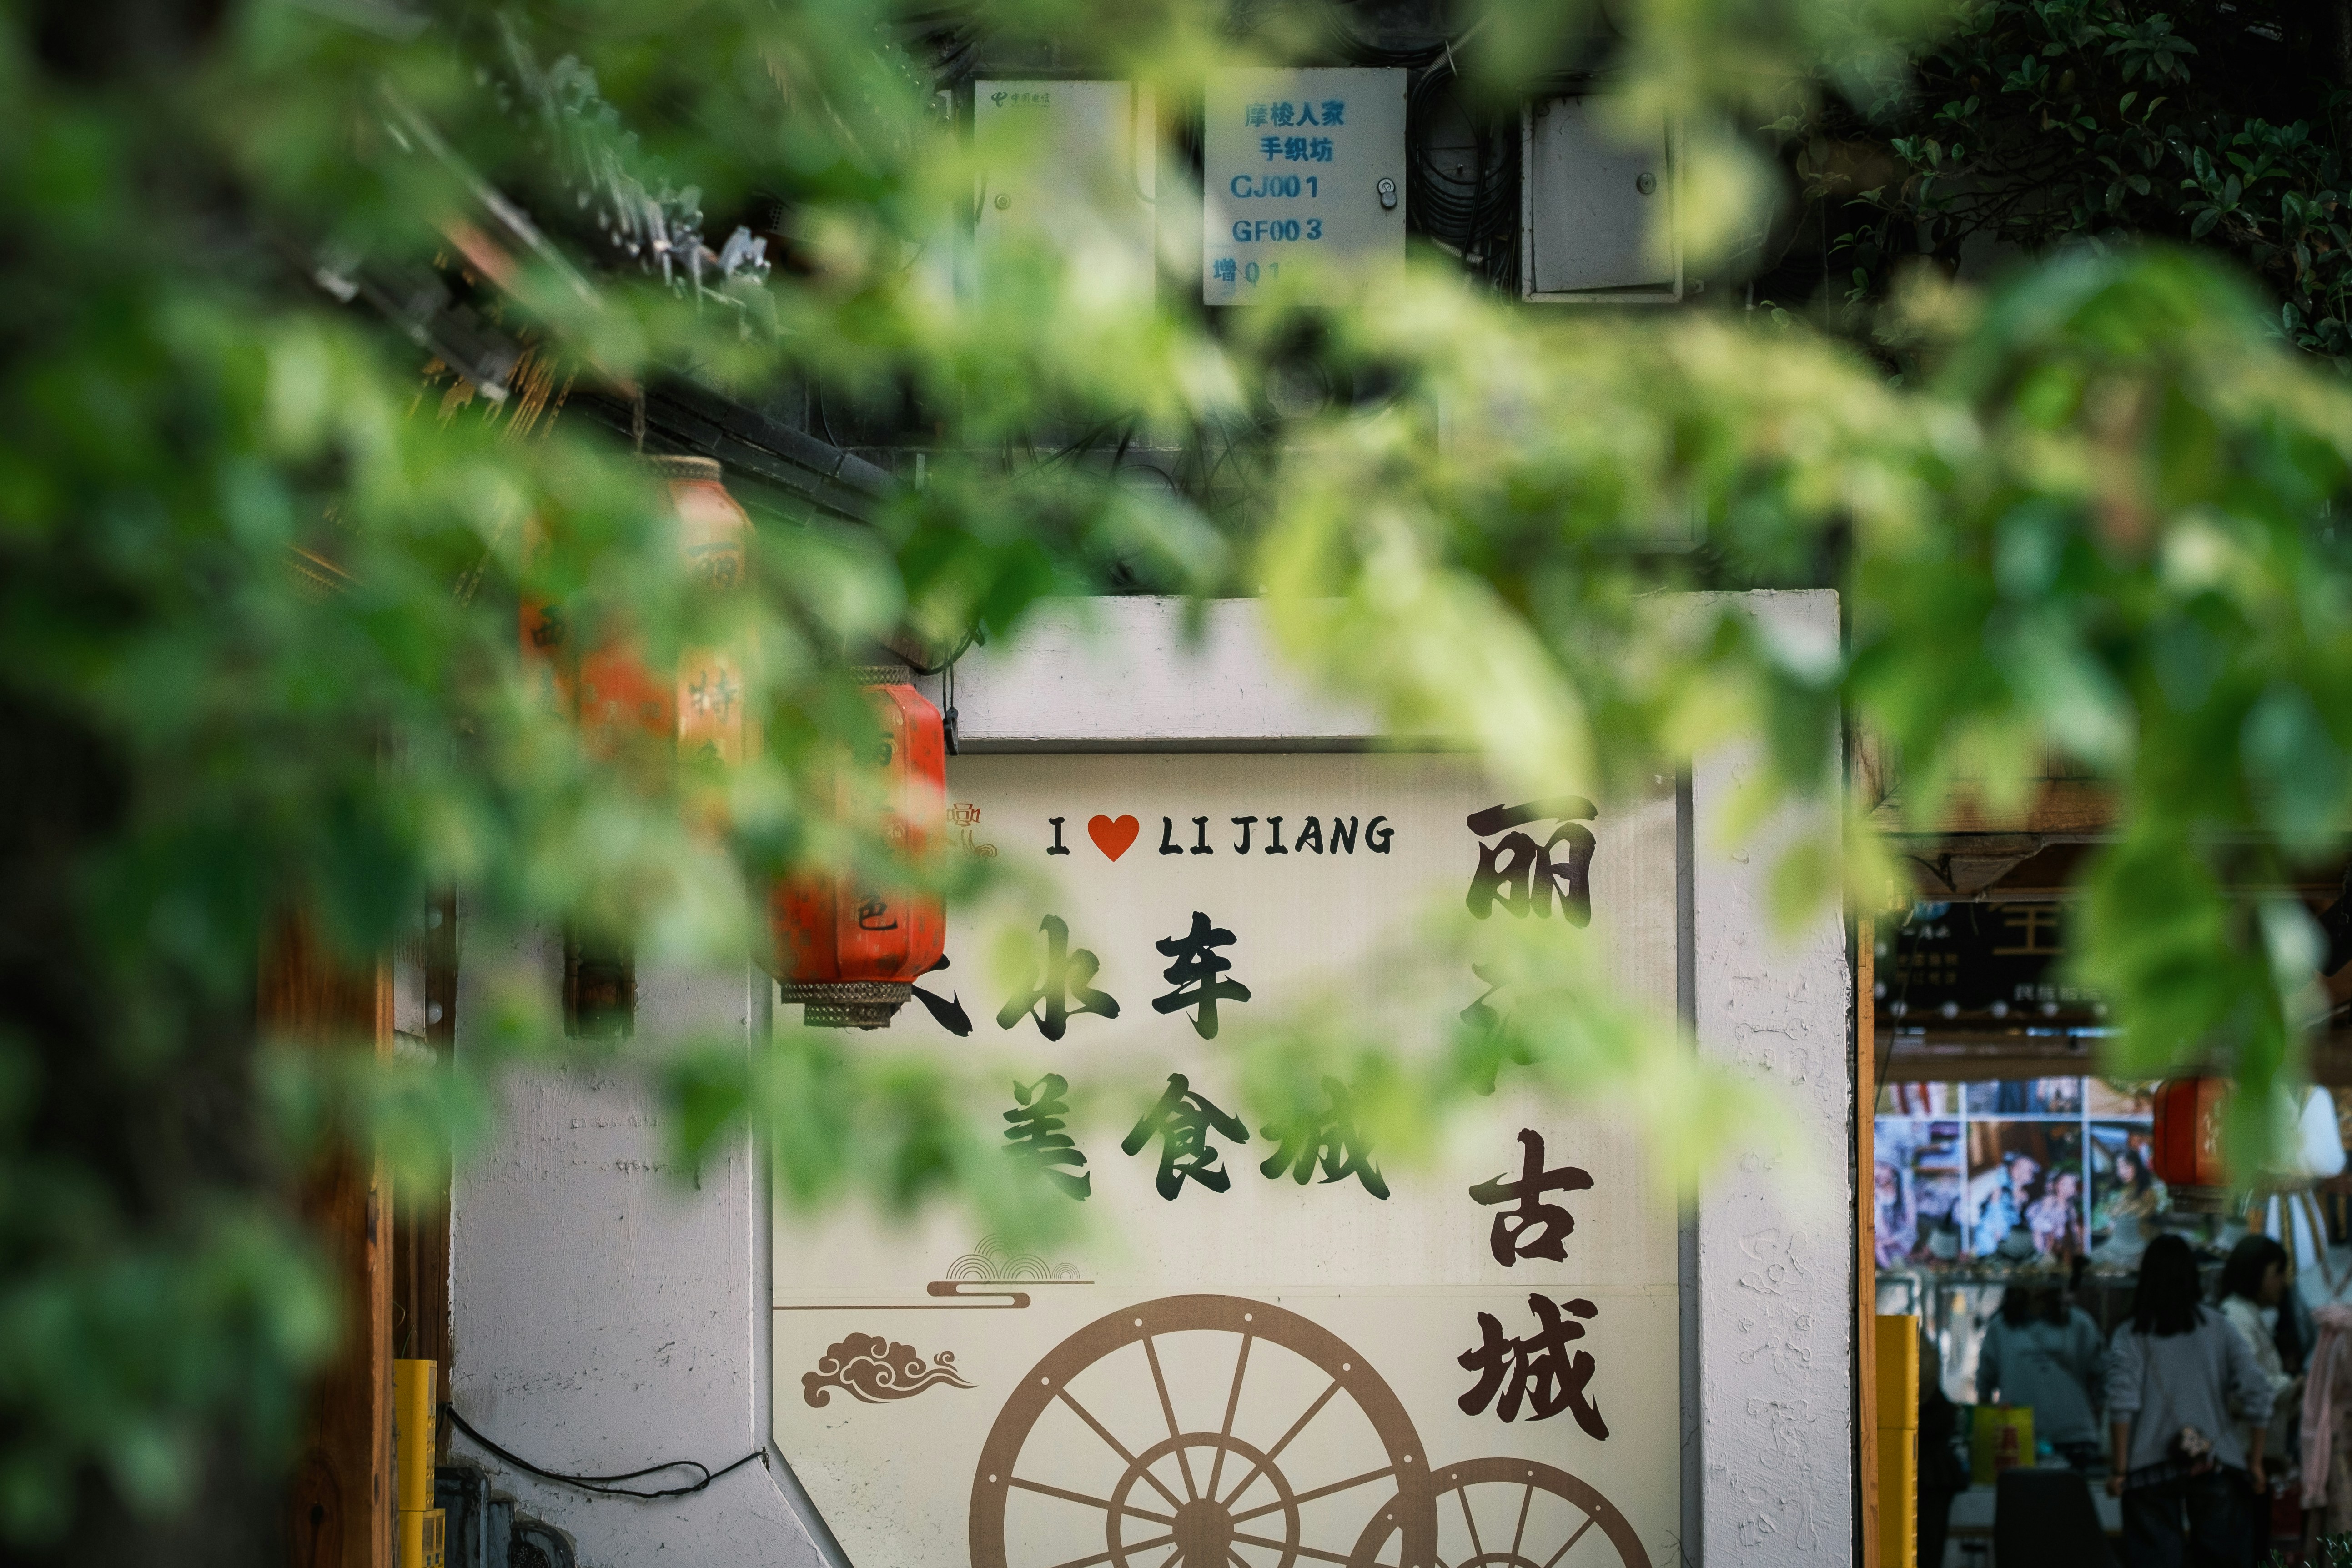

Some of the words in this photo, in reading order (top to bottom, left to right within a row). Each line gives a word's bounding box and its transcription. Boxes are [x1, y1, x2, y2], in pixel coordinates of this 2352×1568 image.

[1245, 101, 1345, 127] 摩梭人家
[1261, 136, 1333, 162] 手织坊
[1232, 218, 1322, 242] GF003
[1047, 816, 1070, 856] I
[859, 911, 1252, 1042] 水车
[1001, 1073, 1391, 1201] 美食城
